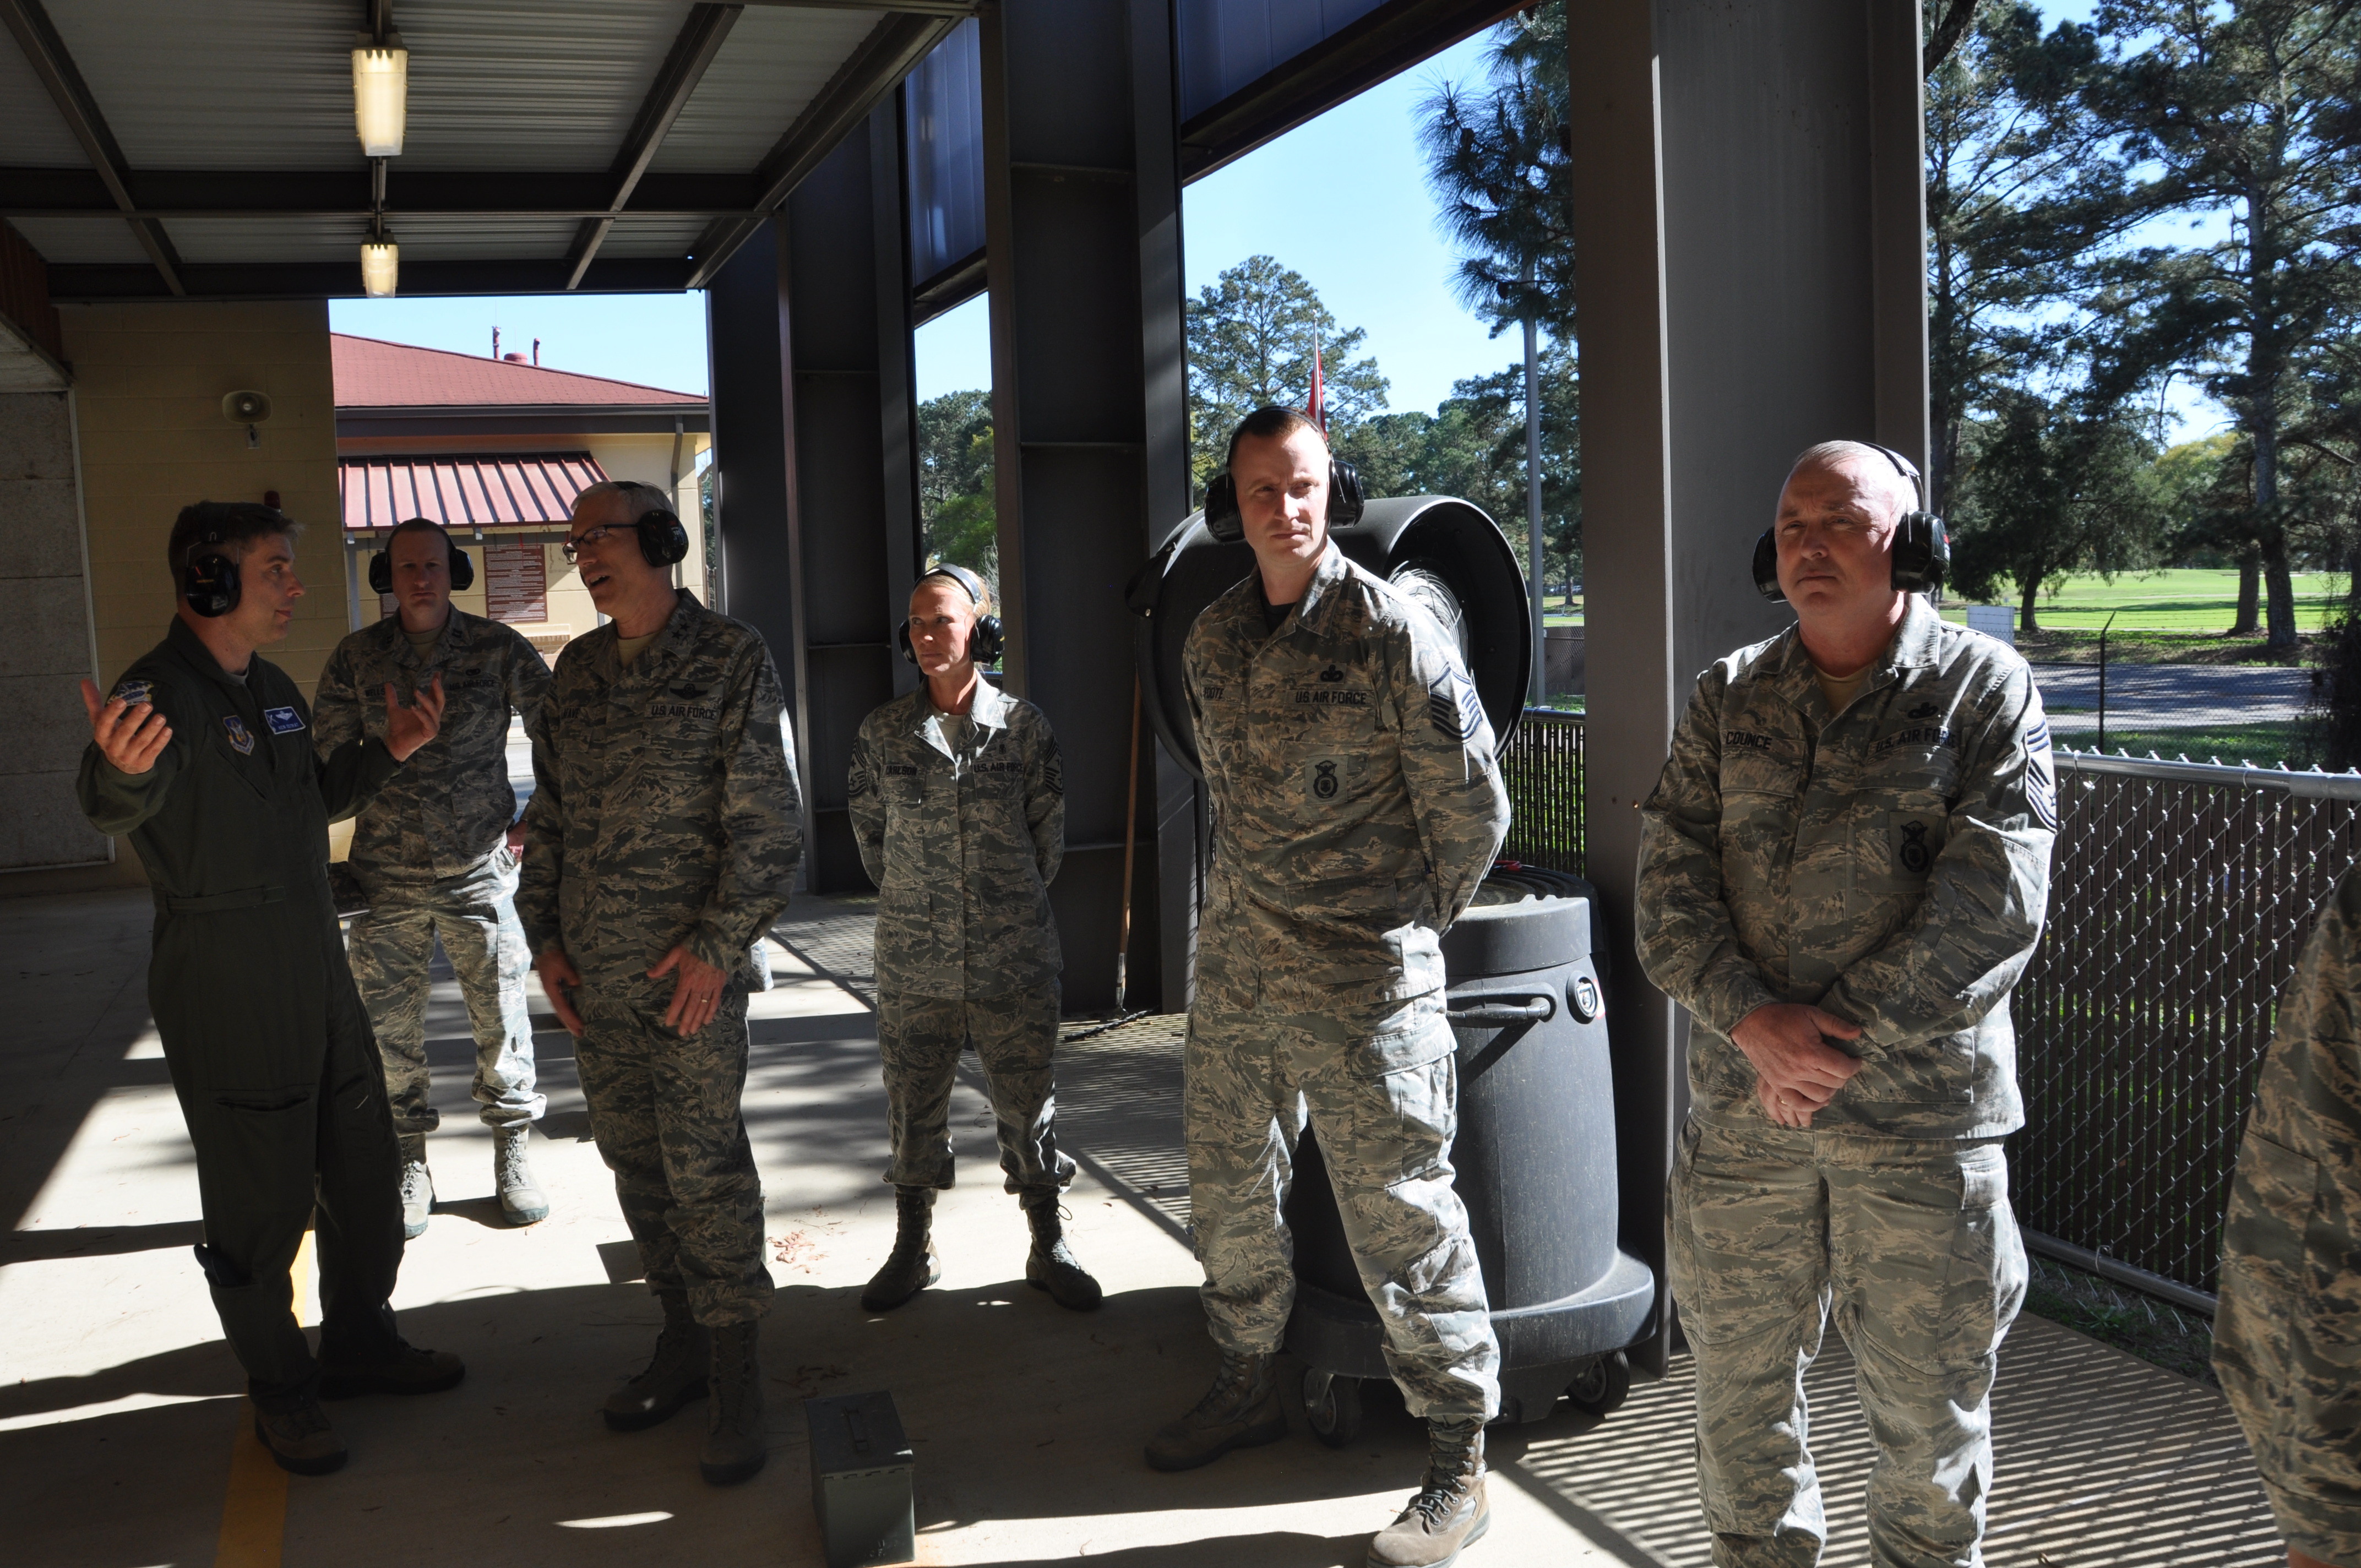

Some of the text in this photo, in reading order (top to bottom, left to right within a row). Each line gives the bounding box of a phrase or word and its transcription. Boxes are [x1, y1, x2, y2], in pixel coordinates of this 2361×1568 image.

[475, 679, 494, 687] FORCE
[1313, 691, 1329, 703] AIR
[1331, 691, 1367, 704] FORCE
[668, 705, 686, 717] AIR
[687, 707, 716, 720] FORCE
[1726, 731, 1772, 750] COUNCE
[1898, 729, 1921, 743] AIR
[1924, 727, 1956, 748] FORCE
[990, 763, 1005, 772] AIR
[1006, 763, 1024, 772] FORCE
